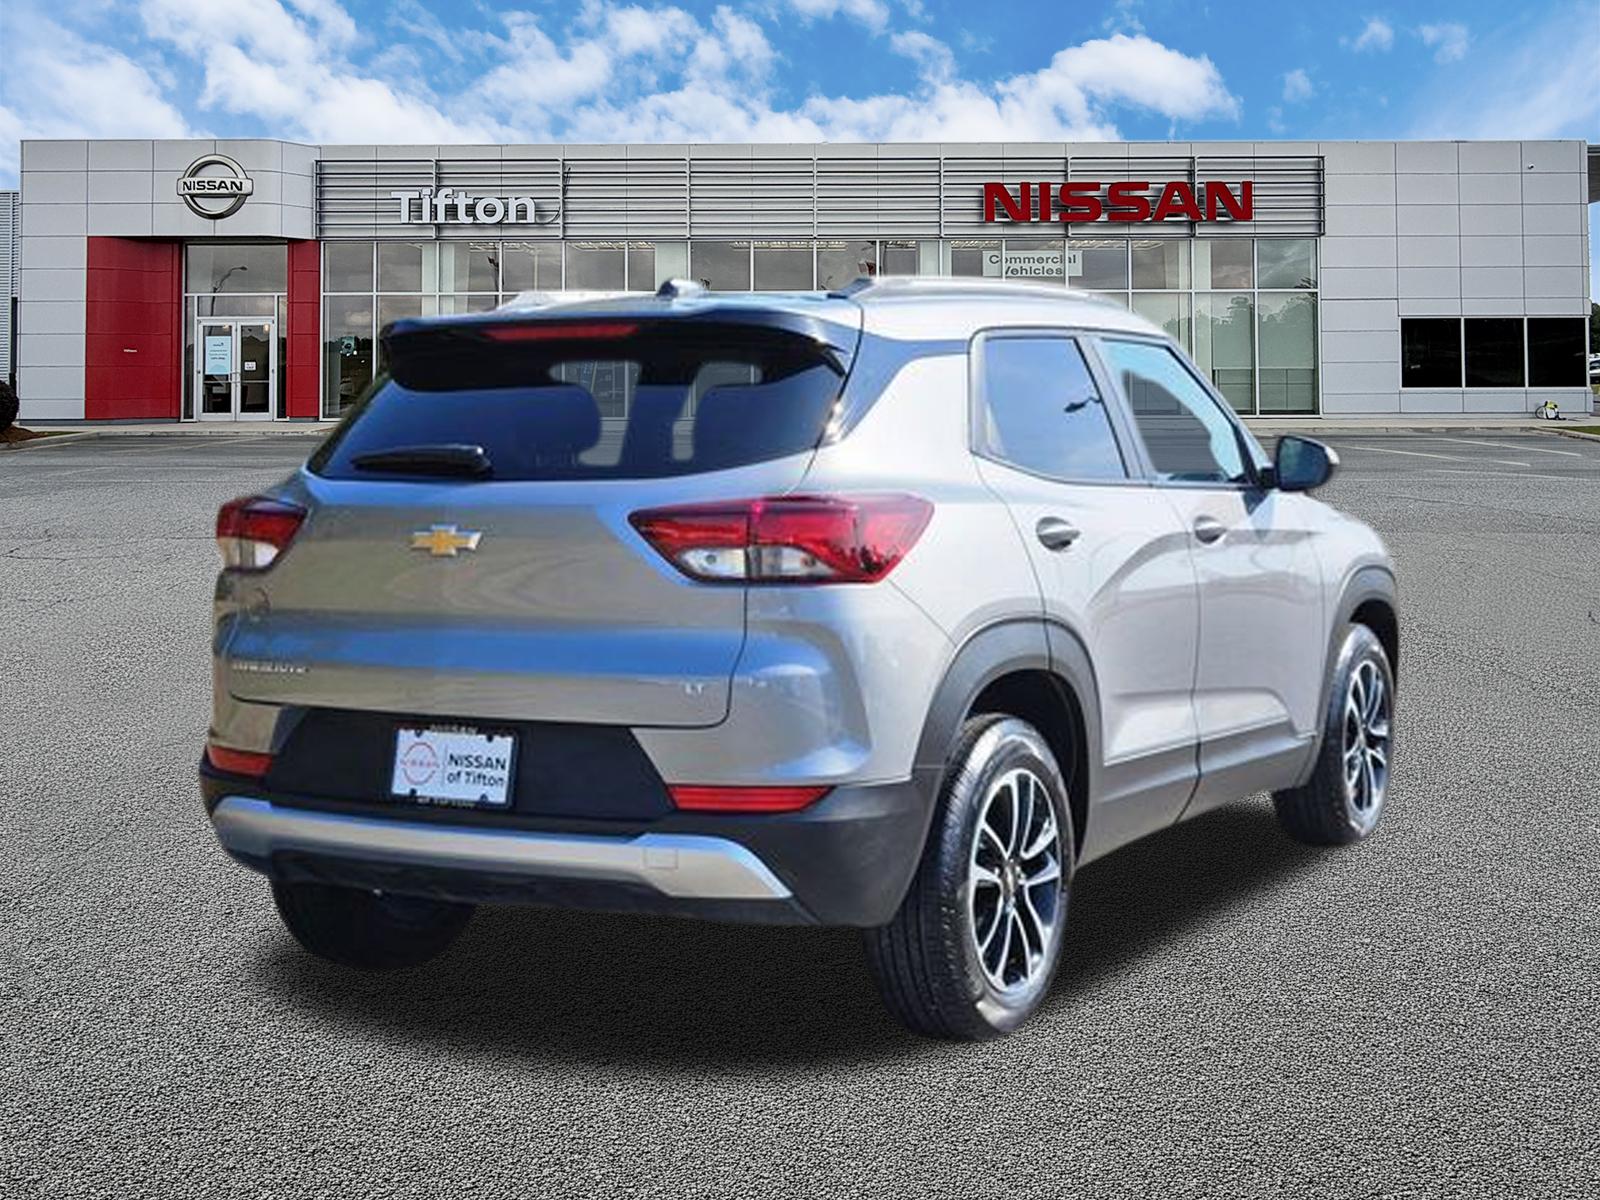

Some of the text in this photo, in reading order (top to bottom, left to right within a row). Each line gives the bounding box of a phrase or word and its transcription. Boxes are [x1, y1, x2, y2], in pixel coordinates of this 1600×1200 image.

[182, 180, 243, 191] NISSAN
[391, 188, 536, 224] Tifton
[983, 181, 1254, 222] NISSAN
[448, 753, 507, 770] NISSAN
[447, 771, 504, 788] of Tifton
